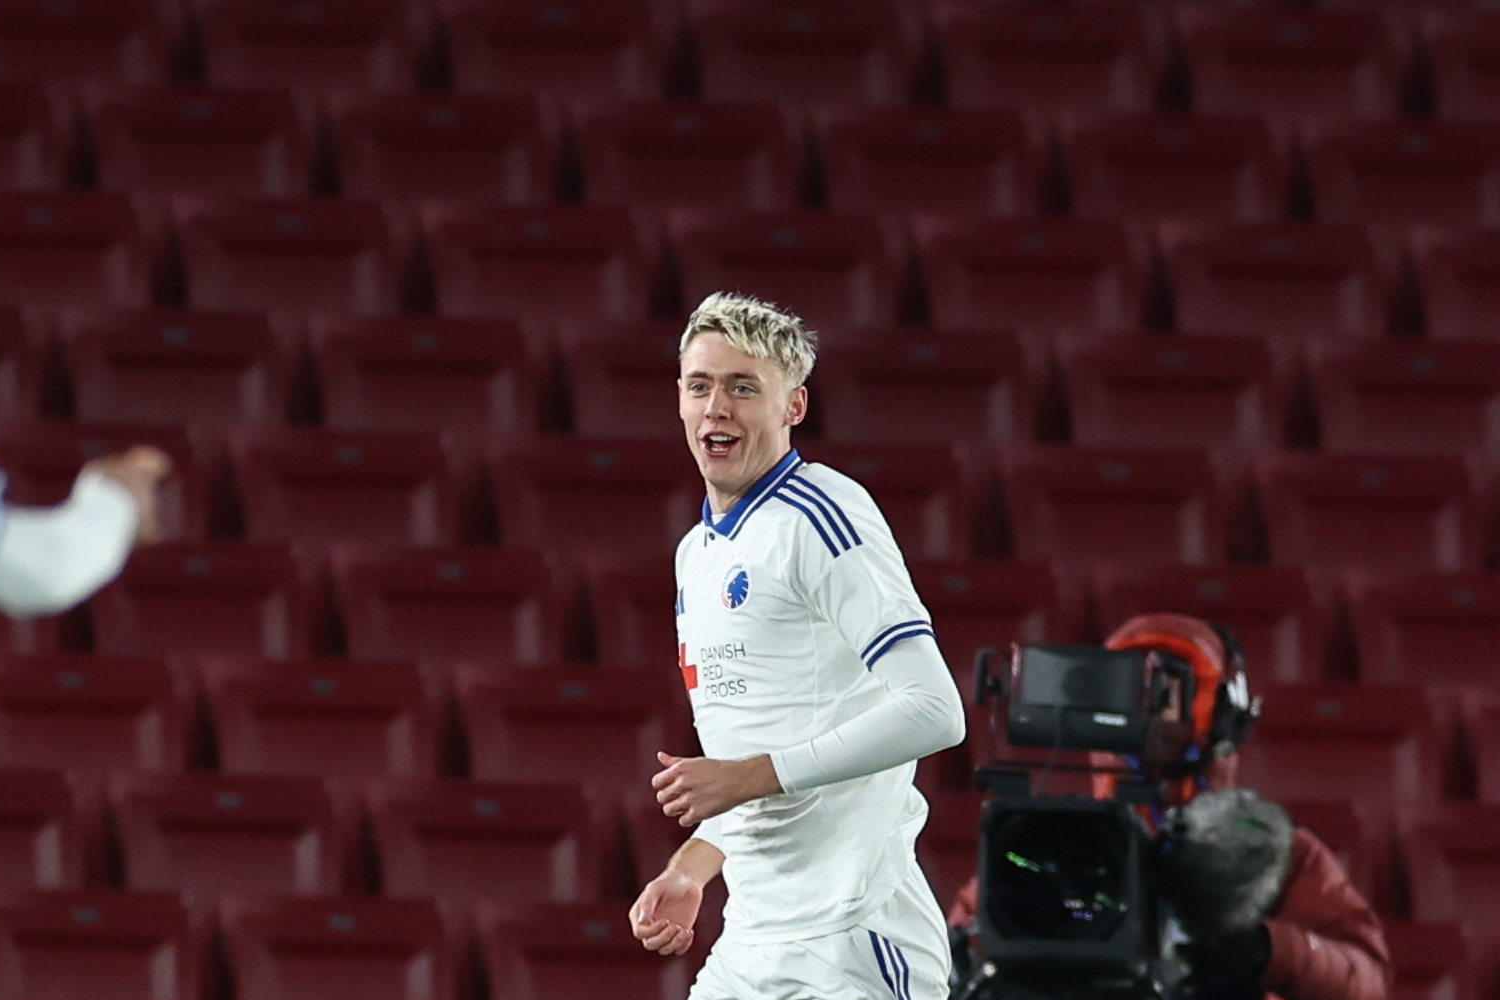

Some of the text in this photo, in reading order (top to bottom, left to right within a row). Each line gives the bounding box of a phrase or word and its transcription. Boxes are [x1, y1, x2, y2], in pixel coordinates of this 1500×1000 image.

[701, 643, 746, 663] DANISH
[703, 664, 723, 681] RED
[705, 679, 747, 700] CROSS
